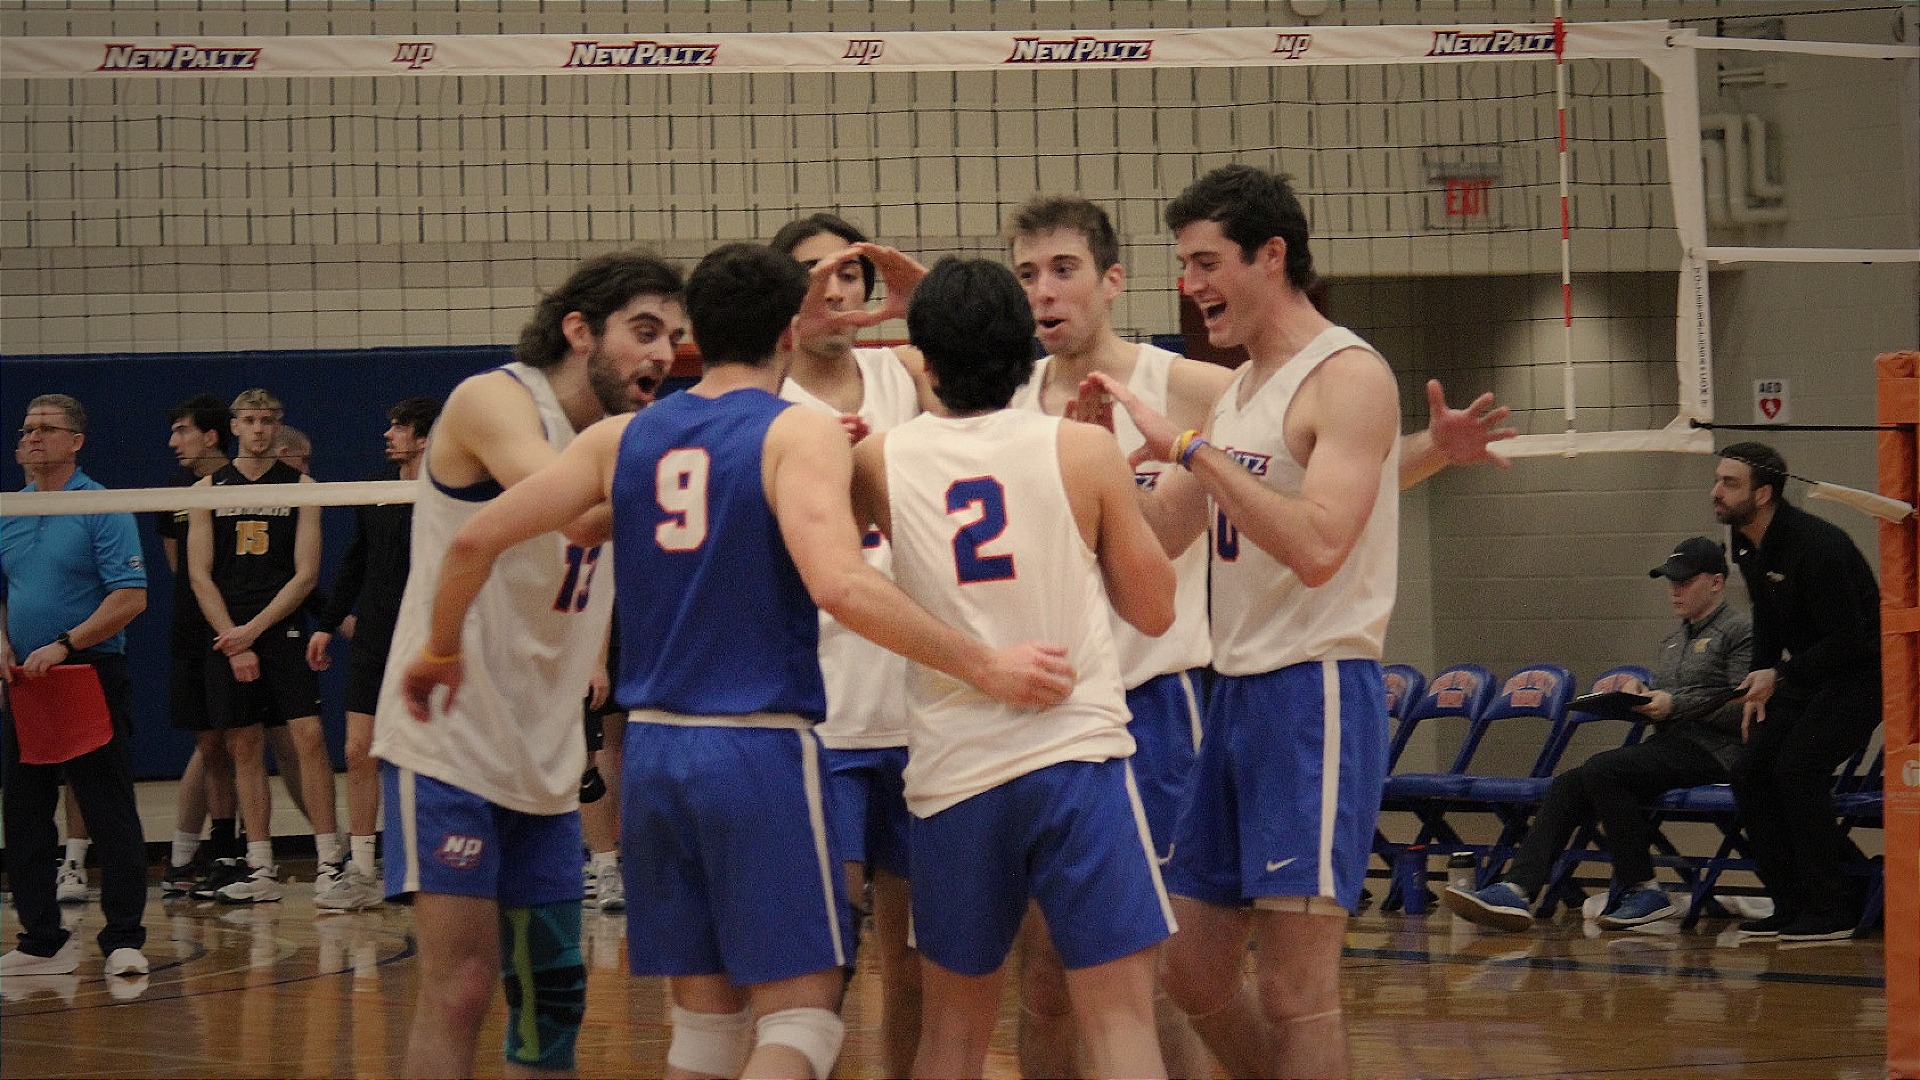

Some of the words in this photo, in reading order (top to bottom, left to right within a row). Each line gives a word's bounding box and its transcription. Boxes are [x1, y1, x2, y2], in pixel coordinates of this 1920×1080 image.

[394, 43, 435, 69] NP
[844, 40, 884, 65] NP
[1274, 34, 1312, 59] NP
[655, 446, 711, 553] 9
[235, 520, 270, 555] 15
[945, 475, 1017, 586] 2
